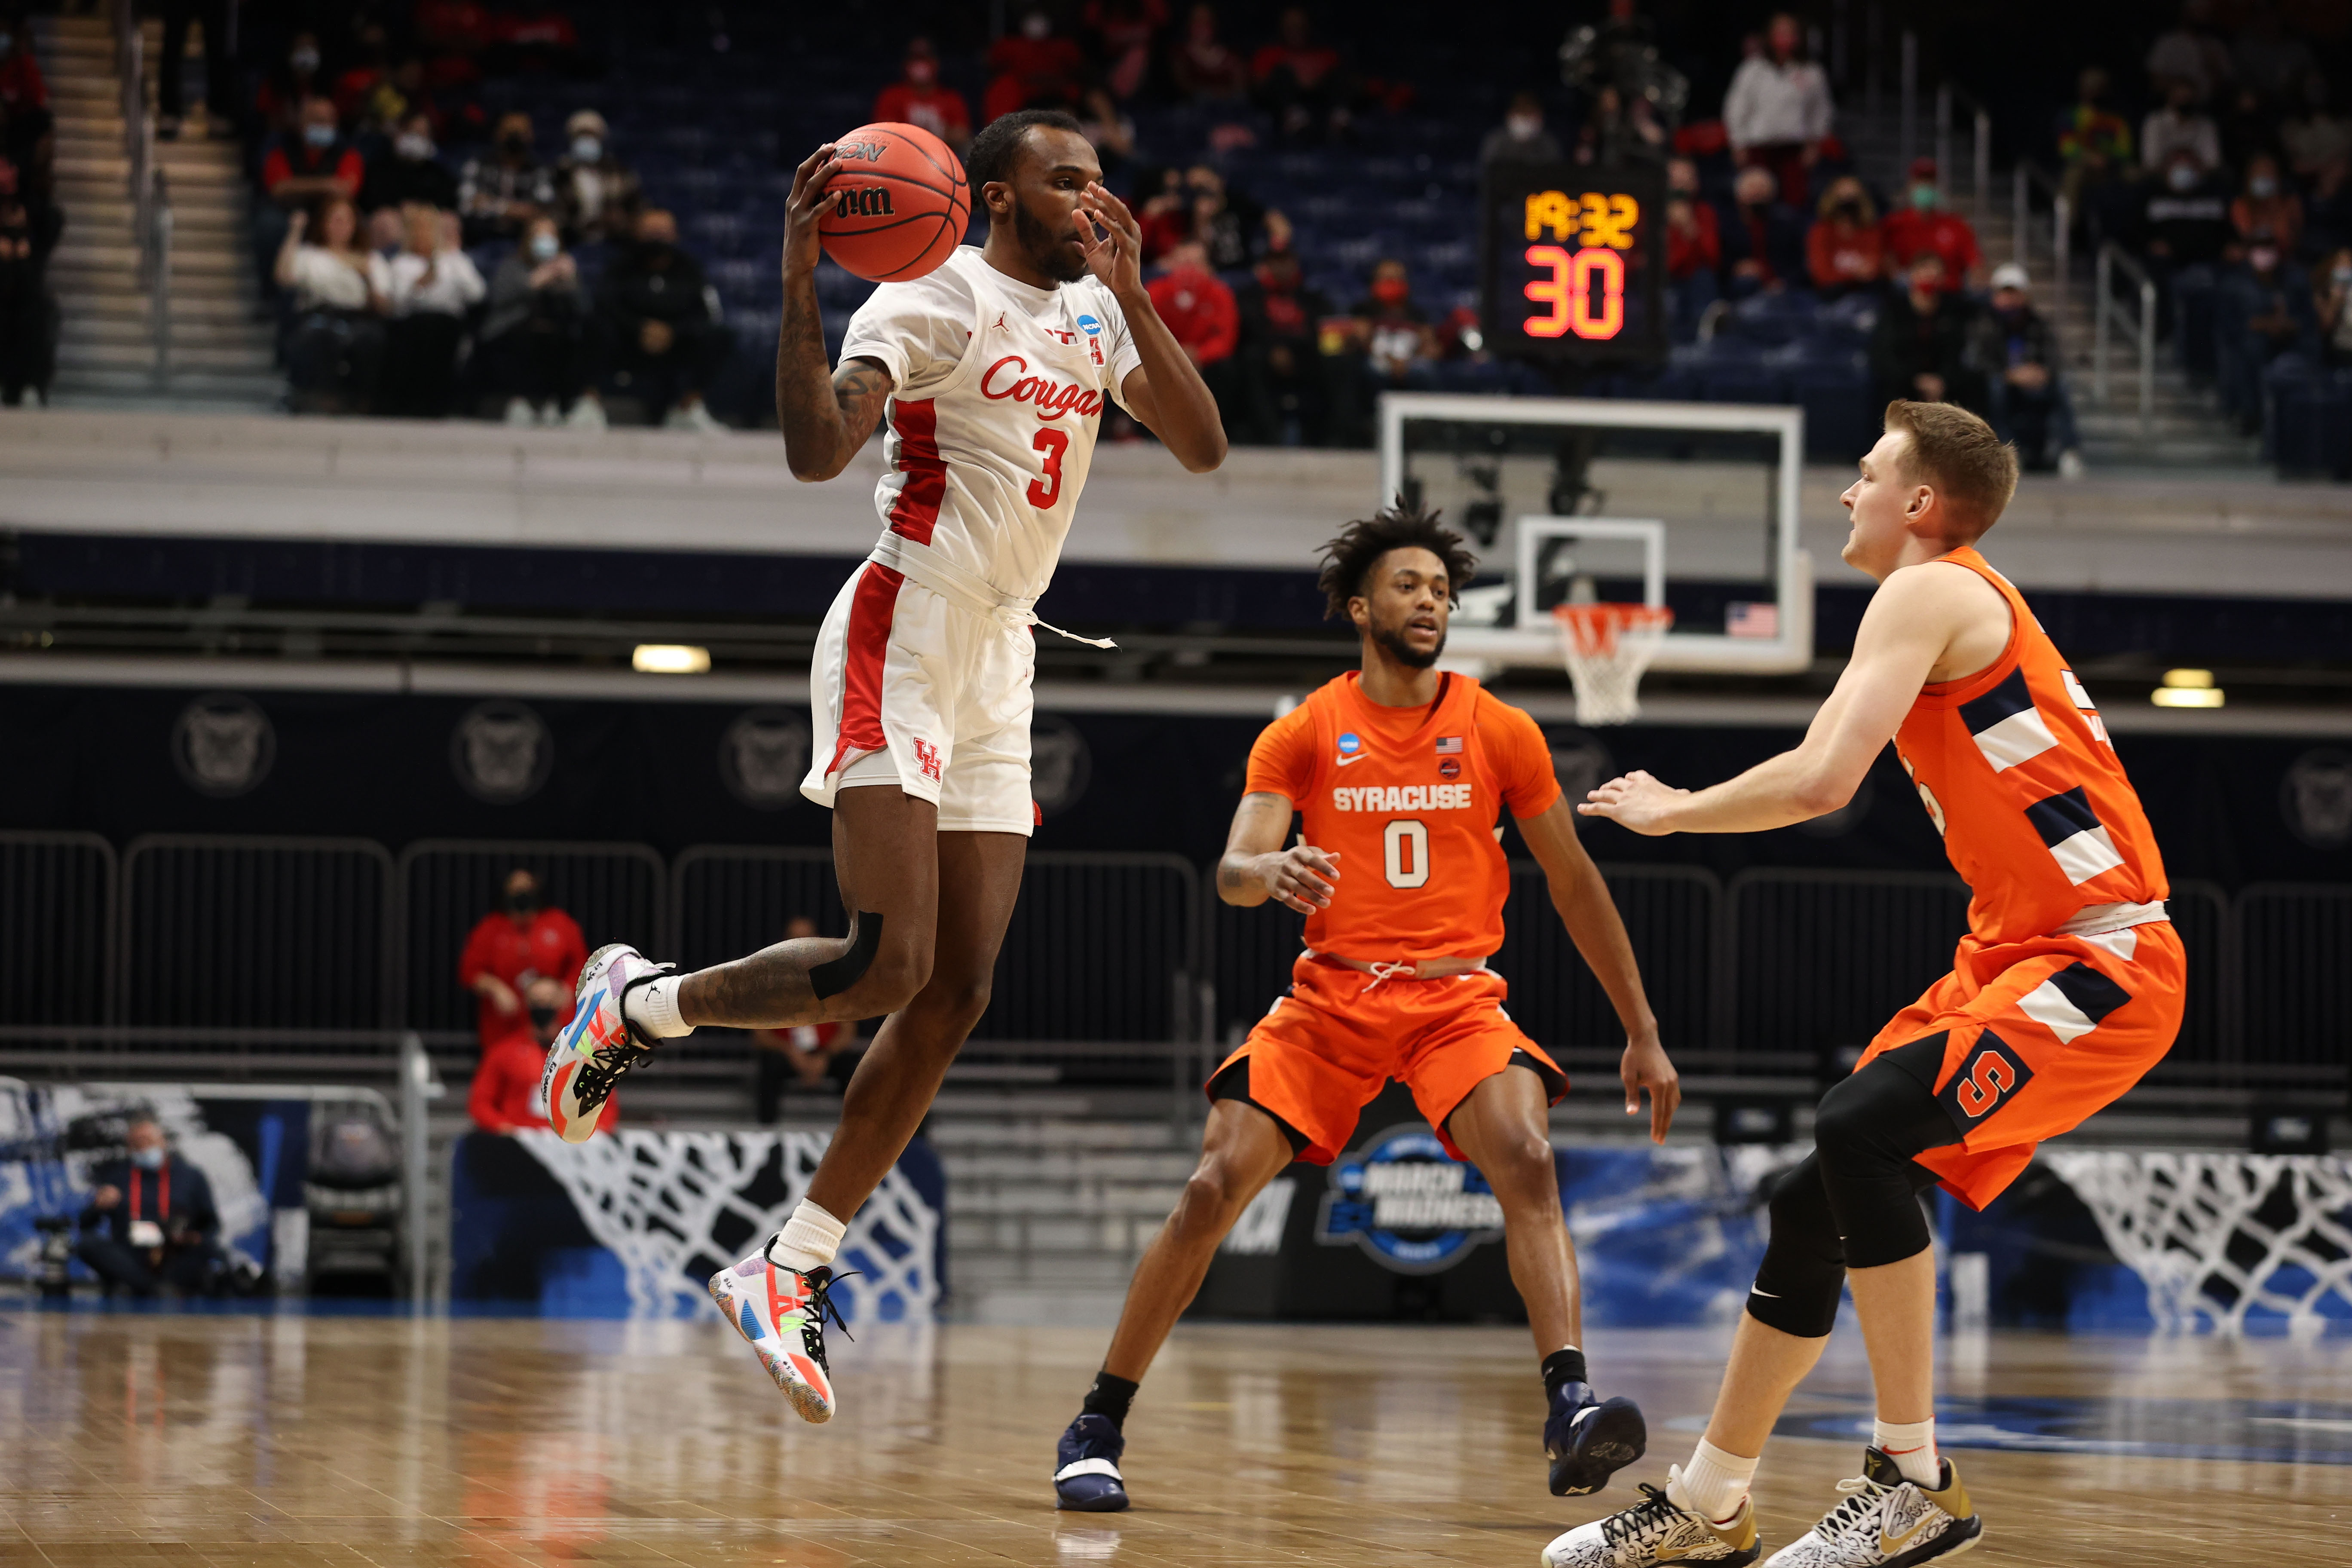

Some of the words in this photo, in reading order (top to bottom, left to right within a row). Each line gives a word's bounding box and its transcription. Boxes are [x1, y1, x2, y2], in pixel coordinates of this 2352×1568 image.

[833, 142, 887, 162] NCA
[819, 187, 895, 218] Wil
[1525, 190, 1639, 250] 19:32
[1524, 245, 1624, 340] 30
[1082, 322, 1101, 331] NCAA
[981, 355, 1105, 421] Couga
[1027, 427, 1069, 509] 3
[913, 737, 942, 783] UH
[1333, 784, 1472, 812] SYRACUSE
[1384, 820, 1429, 889] 0
[1957, 1050, 2015, 1118] S
